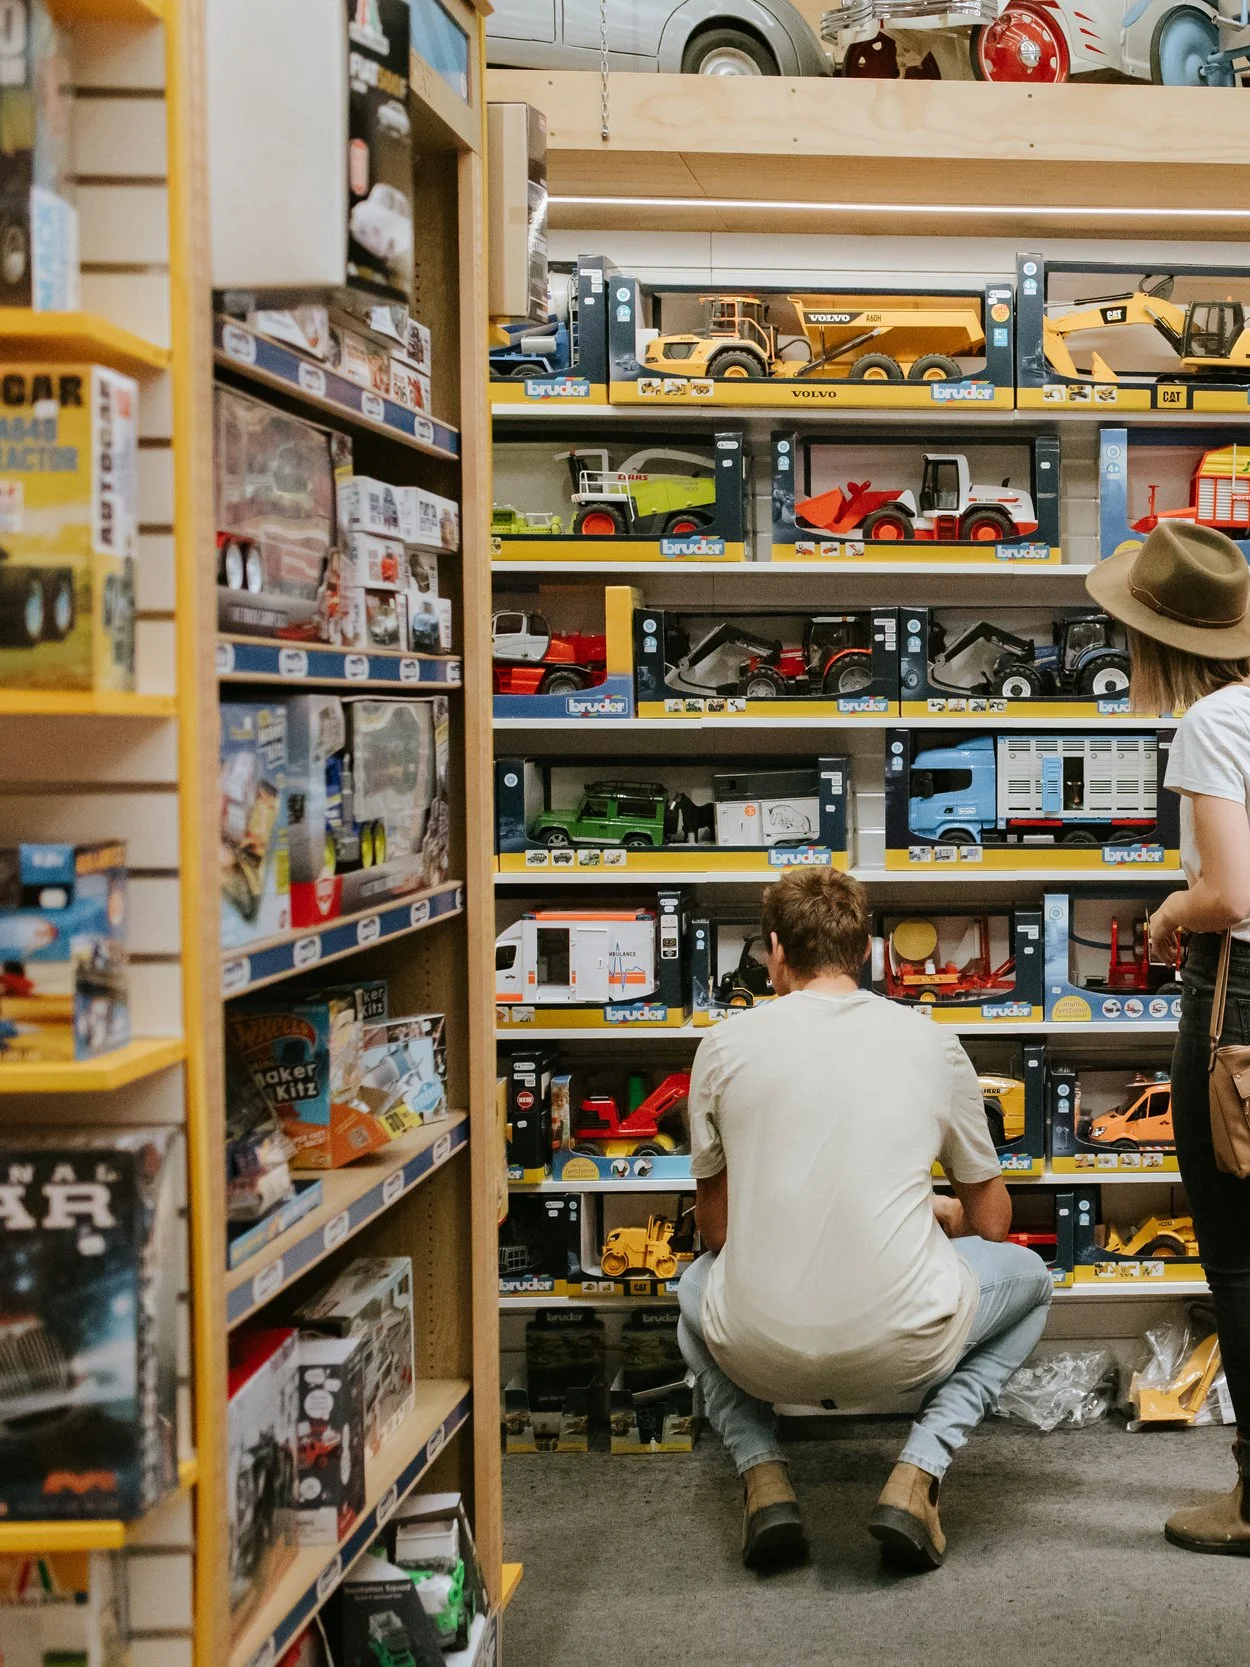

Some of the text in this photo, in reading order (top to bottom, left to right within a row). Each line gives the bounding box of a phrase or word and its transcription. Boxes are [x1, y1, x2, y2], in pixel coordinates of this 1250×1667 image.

[808, 314, 882, 322] VOLVO A60H
[1106, 310, 1122, 321] CAT
[527, 380, 588, 396] bruder
[791, 390, 837, 398] VOLVO
[933, 384, 993, 400] bruder
[1163, 391, 1180, 403] CAT
[663, 539, 723, 555] bruder
[997, 545, 1048, 559] bruder
[569, 699, 626, 713] bruder
[839, 699, 887, 712] bruder
[1098, 700, 1133, 713] brud
[771, 849, 828, 864] bruder
[1104, 847, 1162, 862] bruder
[364, 988, 385, 1001] ker
[606, 1006, 665, 1021] bruder
[983, 1004, 1030, 1017] bruder
[276, 1082, 318, 1100] Kitz
[499, 1279, 552, 1291] bruder
[546, 1312, 583, 1322] bruder
